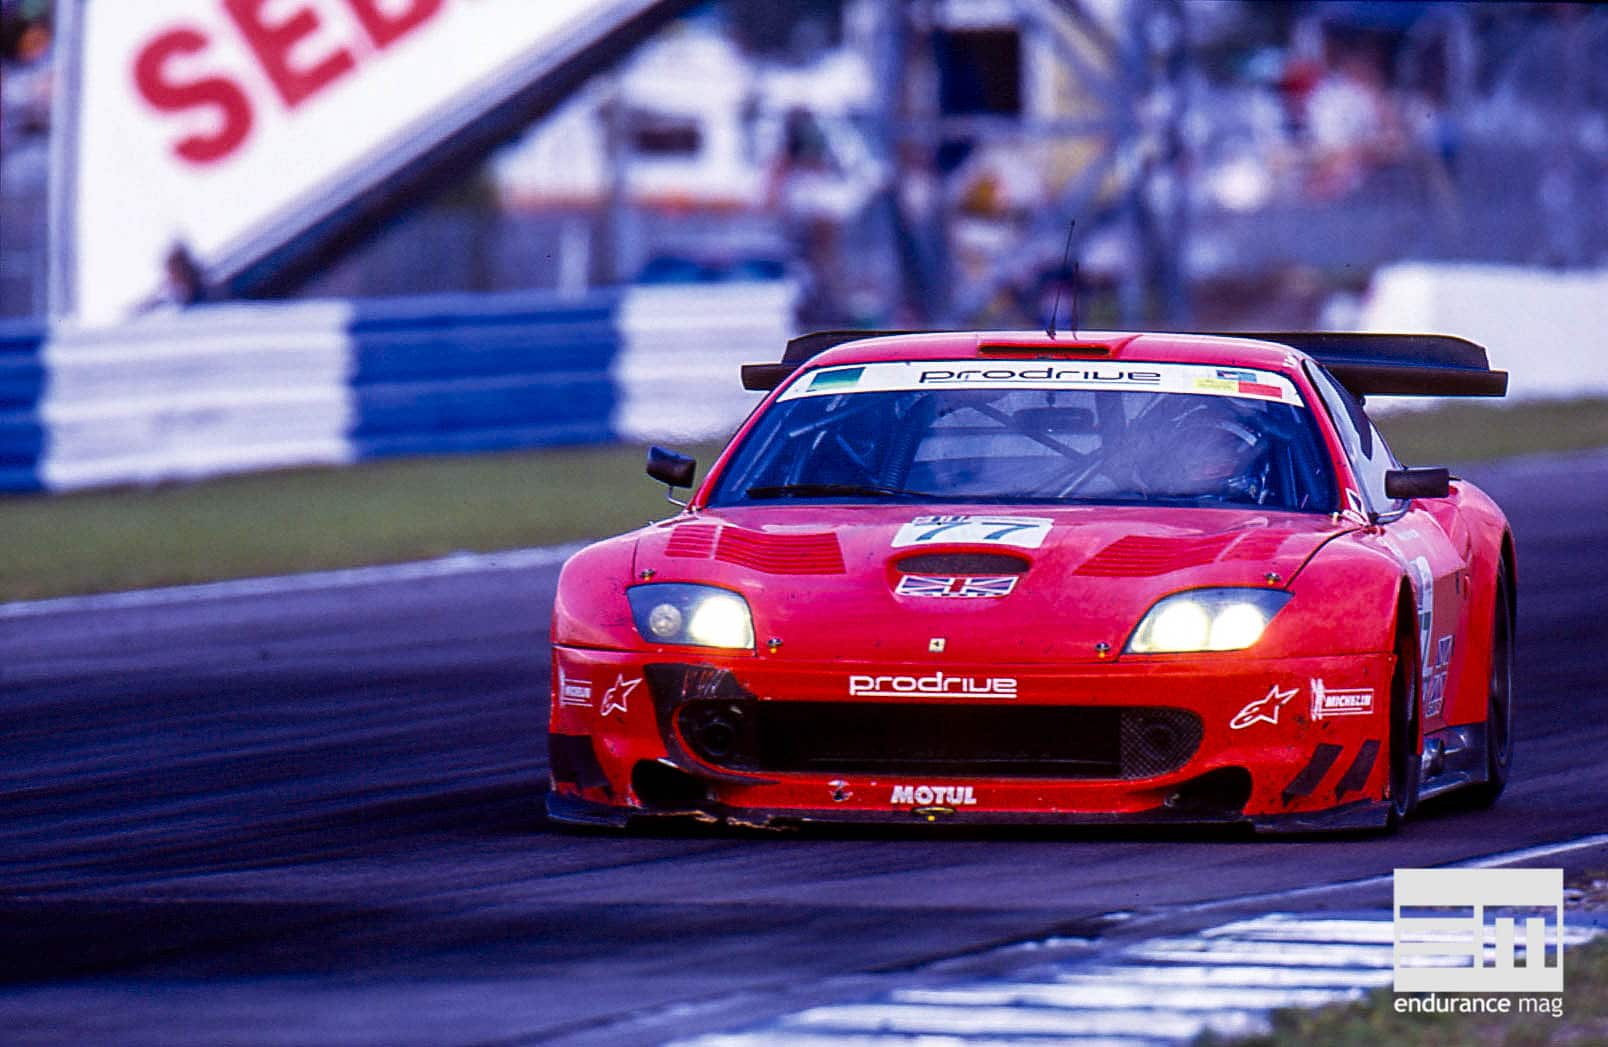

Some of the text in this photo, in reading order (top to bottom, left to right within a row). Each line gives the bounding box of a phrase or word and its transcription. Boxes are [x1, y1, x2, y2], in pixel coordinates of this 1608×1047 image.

[919, 367, 1161, 383] prodrive
[915, 521, 1040, 541] 77
[849, 671, 1018, 696] prodrive
[890, 785, 977, 805] MOTUL
